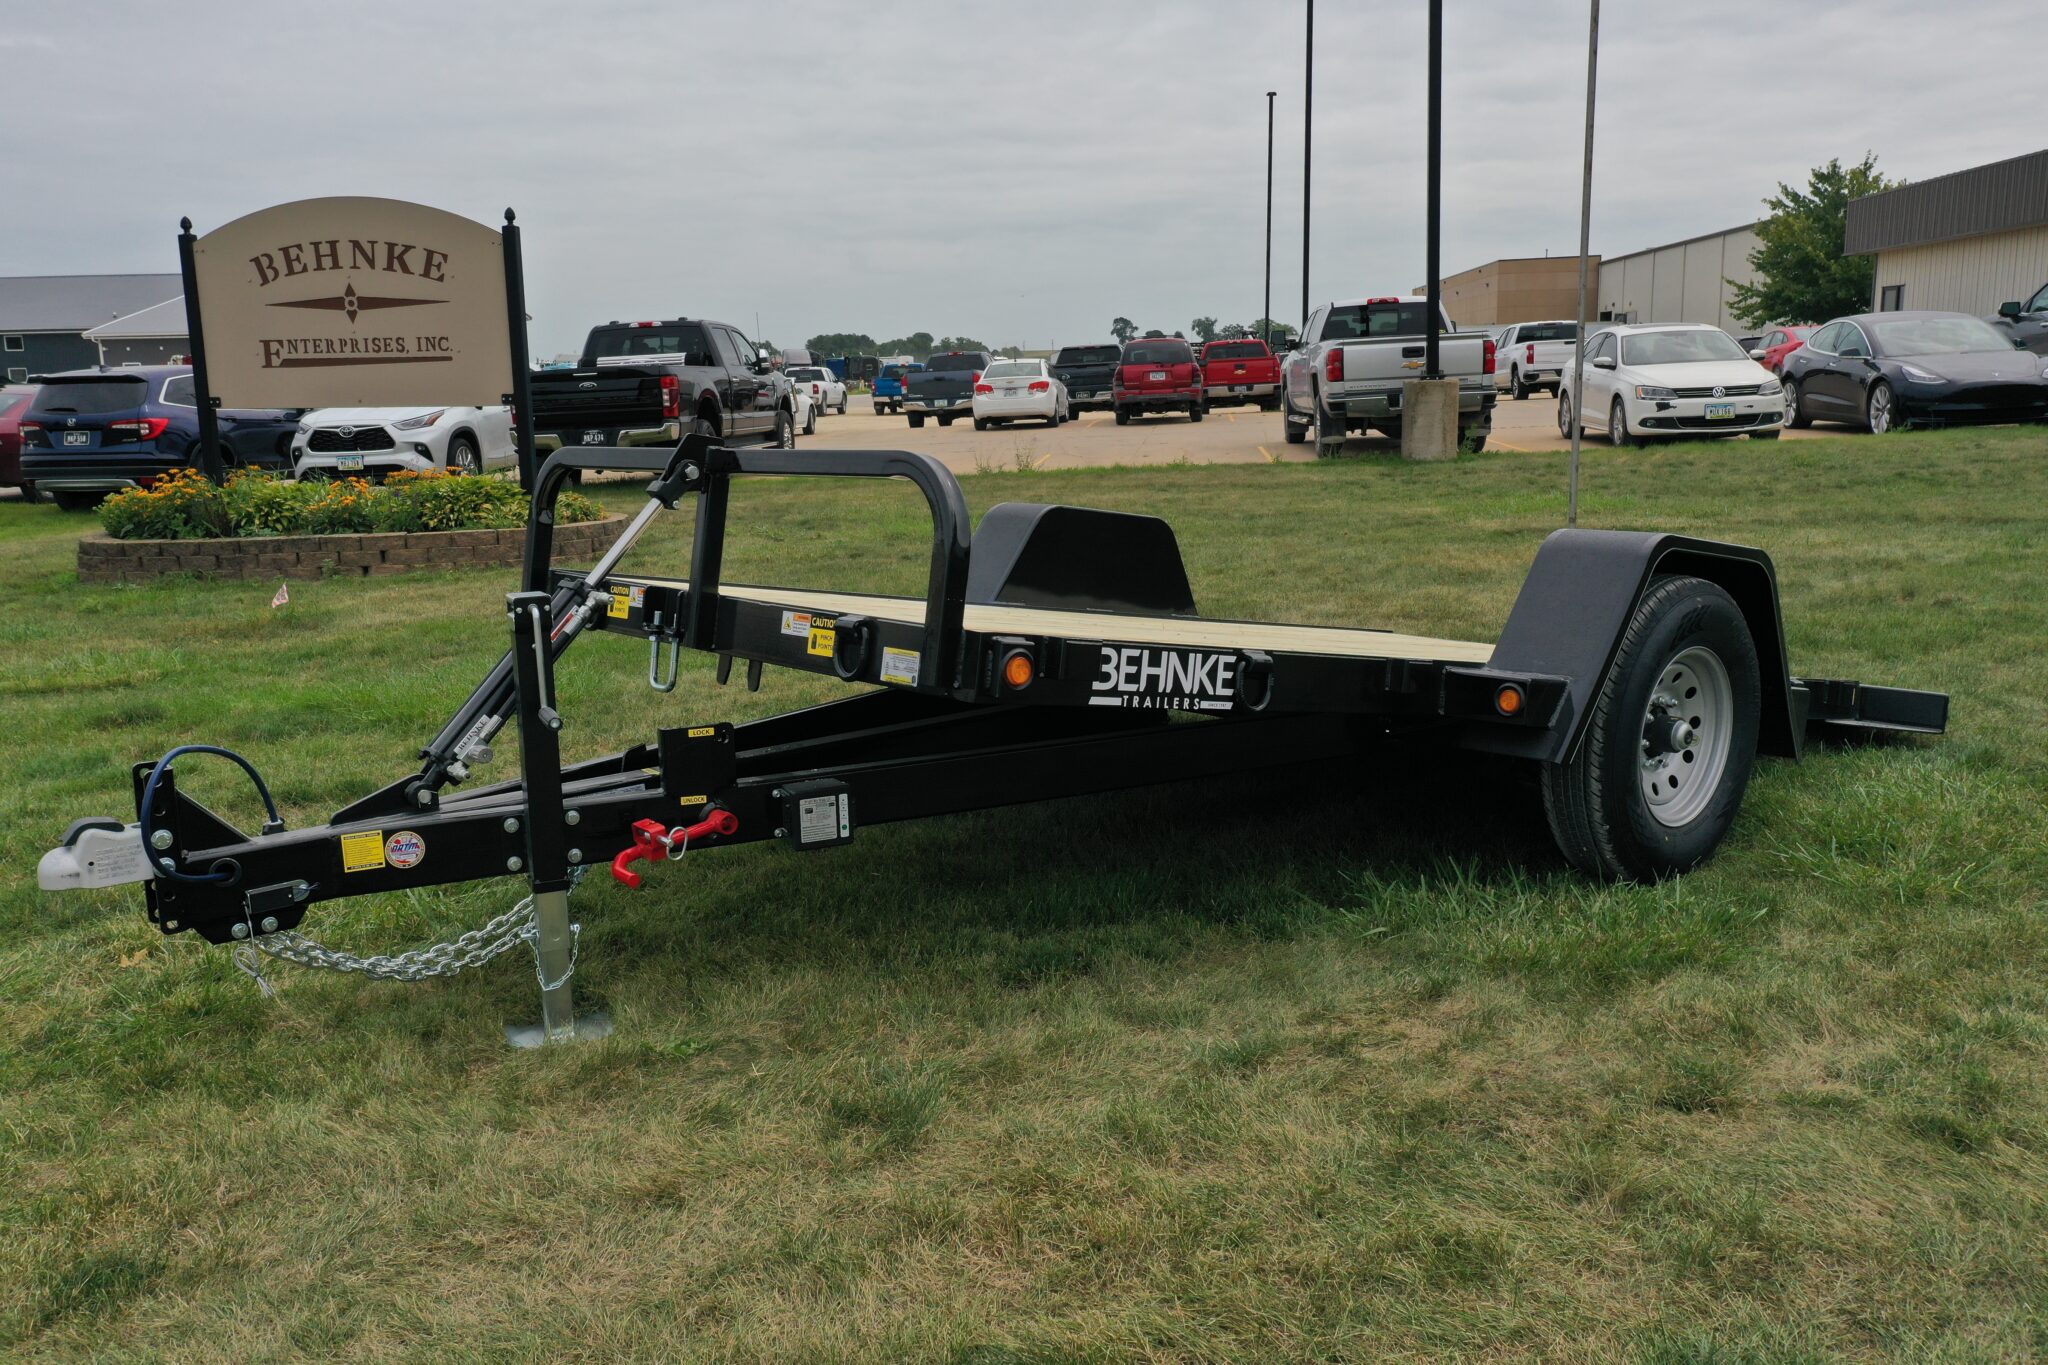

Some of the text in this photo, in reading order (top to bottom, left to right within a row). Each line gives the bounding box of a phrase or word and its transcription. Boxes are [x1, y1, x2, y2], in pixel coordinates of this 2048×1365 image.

[249, 239, 449, 287] BEHNKE
[259, 336, 454, 369] ENTERPRISES, INC.
[610, 585, 629, 596] CAUTION
[1091, 646, 1238, 696] BEHNKE
[1122, 695, 1200, 710] TRAILERS
[683, 796, 705, 804] UNLOCK
